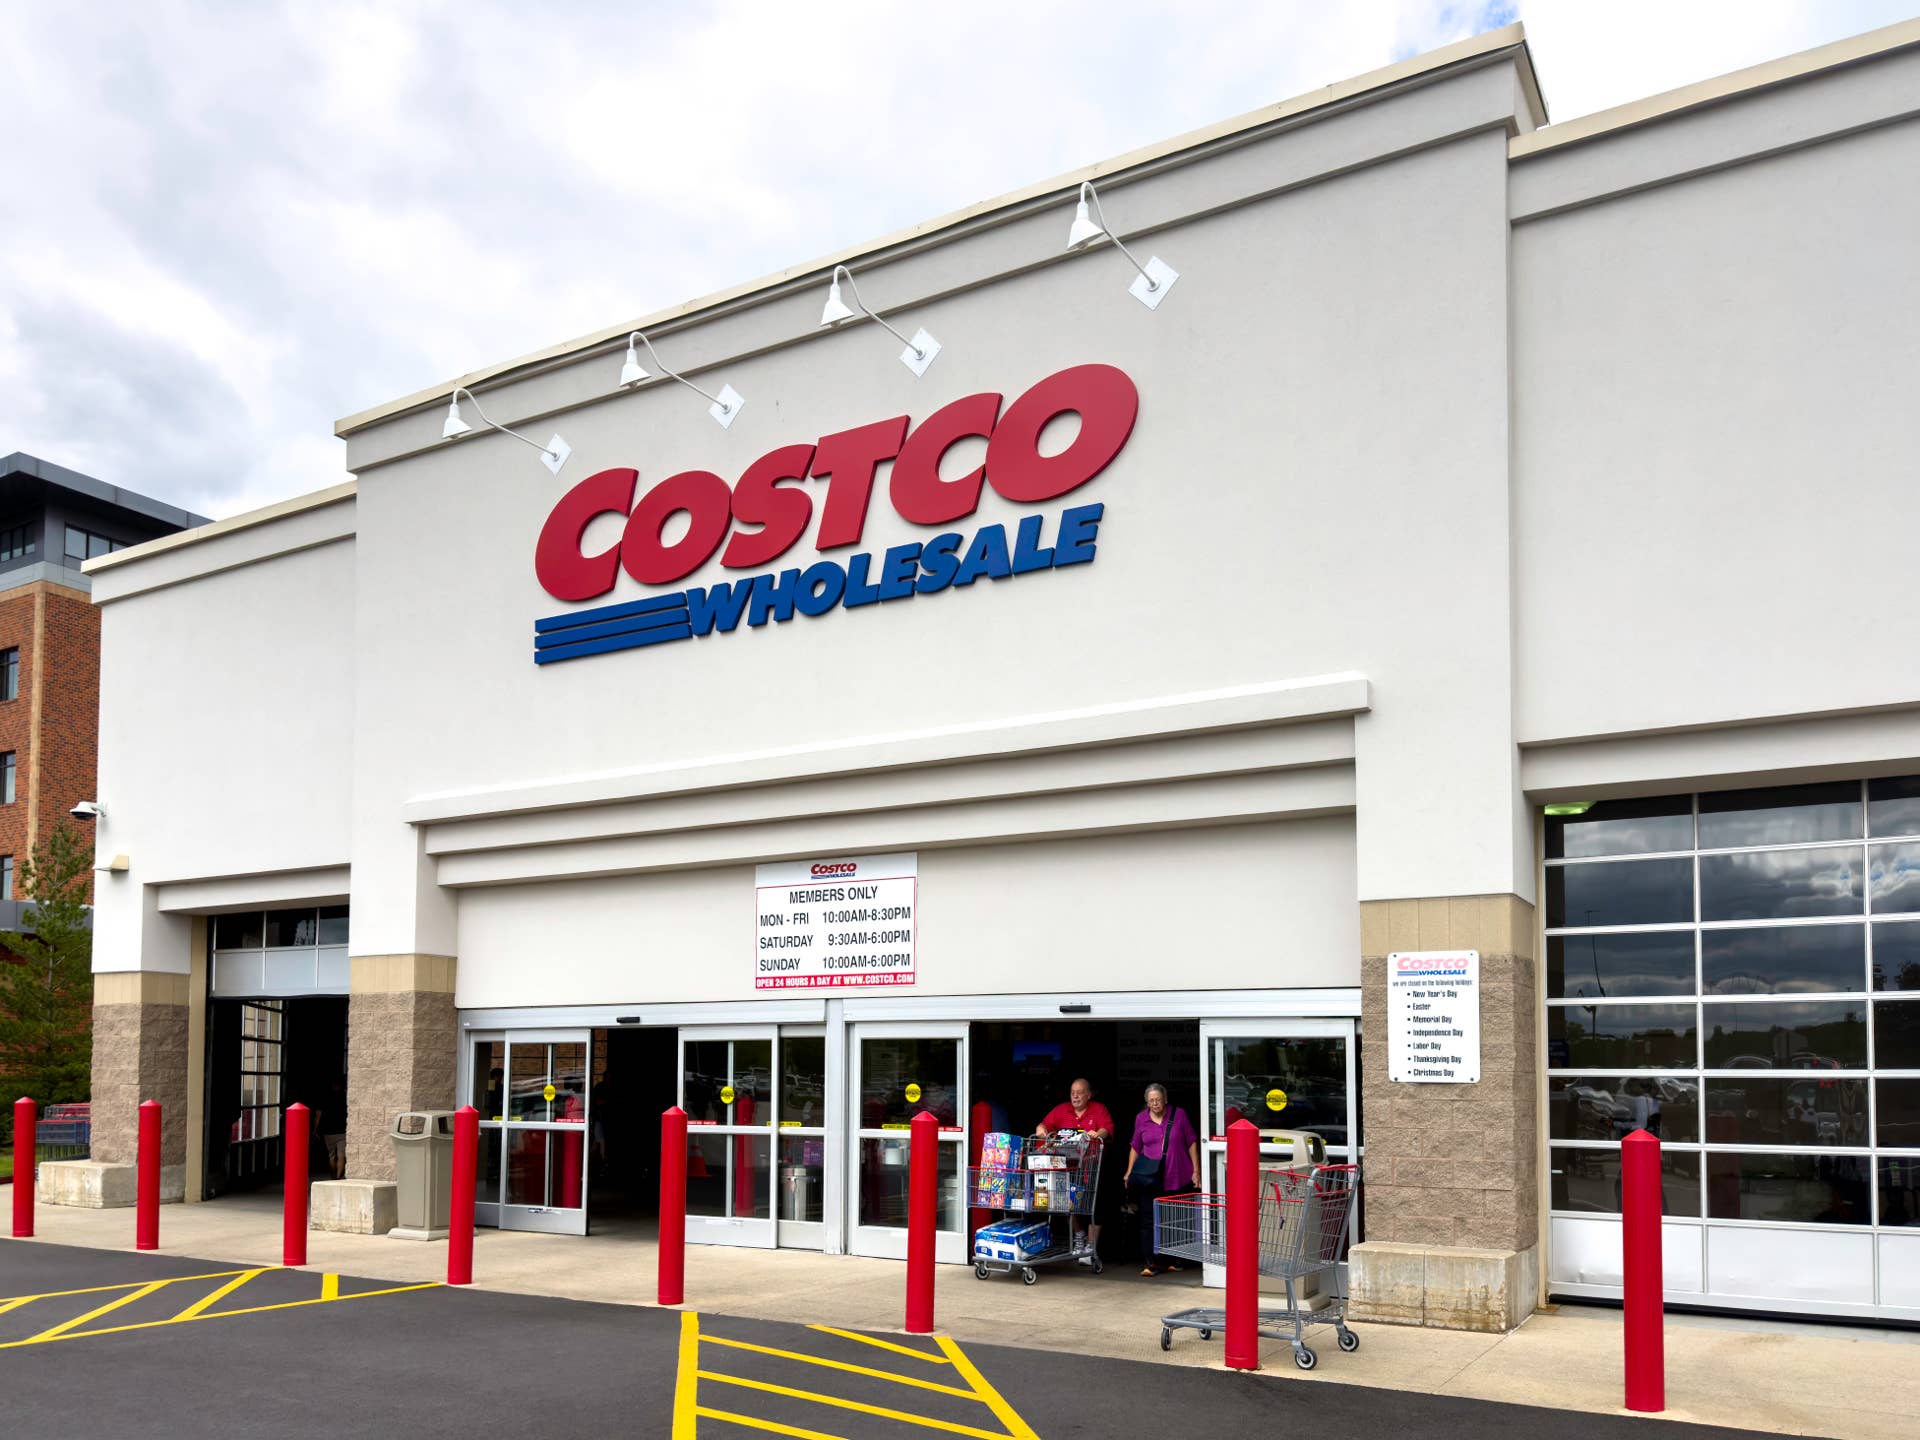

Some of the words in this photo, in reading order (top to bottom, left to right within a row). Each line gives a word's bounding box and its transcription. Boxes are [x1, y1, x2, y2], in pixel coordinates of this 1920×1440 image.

[535, 363, 1139, 602] COSTCO
[686, 503, 1104, 637] WHOLESALE
[811, 863, 857, 875] COSTCO
[789, 888, 844, 904] MEMBERS
[847, 886, 878, 900] ONLY
[760, 914, 784, 927] MON
[793, 913, 809, 925] FRI
[822, 907, 911, 924] 10:00AM-8:30PM
[760, 935, 813, 949] SATURDAY
[828, 930, 911, 946] 9:30AM-6:00PM
[760, 959, 800, 972] SUNDAY
[822, 954, 911, 970] 10:00AM-6:00PM
[1397, 957, 1469, 970] COSTCO
[756, 979, 774, 987] OPEN
[775, 979, 784, 987] 24
[786, 977, 808, 986] HOURS
[810, 977, 815, 985] A
[817, 976, 830, 985] DAY
[833, 976, 841, 984] AT
[843, 974, 913, 984] WWW.COSTCO.COM
[1427, 990, 1446, 998] Year's
[1447, 990, 1457, 998] Day
[1442, 1016, 1452, 1024] Day
[1412, 1029, 1451, 1037] Independence
[1452, 1029, 1463, 1038] Day
[1412, 1042, 1429, 1050] Labor
[1430, 1042, 1441, 1051] Day
[1413, 1055, 1450, 1064] Thanksgiving
[1451, 1056, 1462, 1064] Day
[1413, 1069, 1443, 1077] Christmas
[1443, 1069, 1455, 1078] Day
